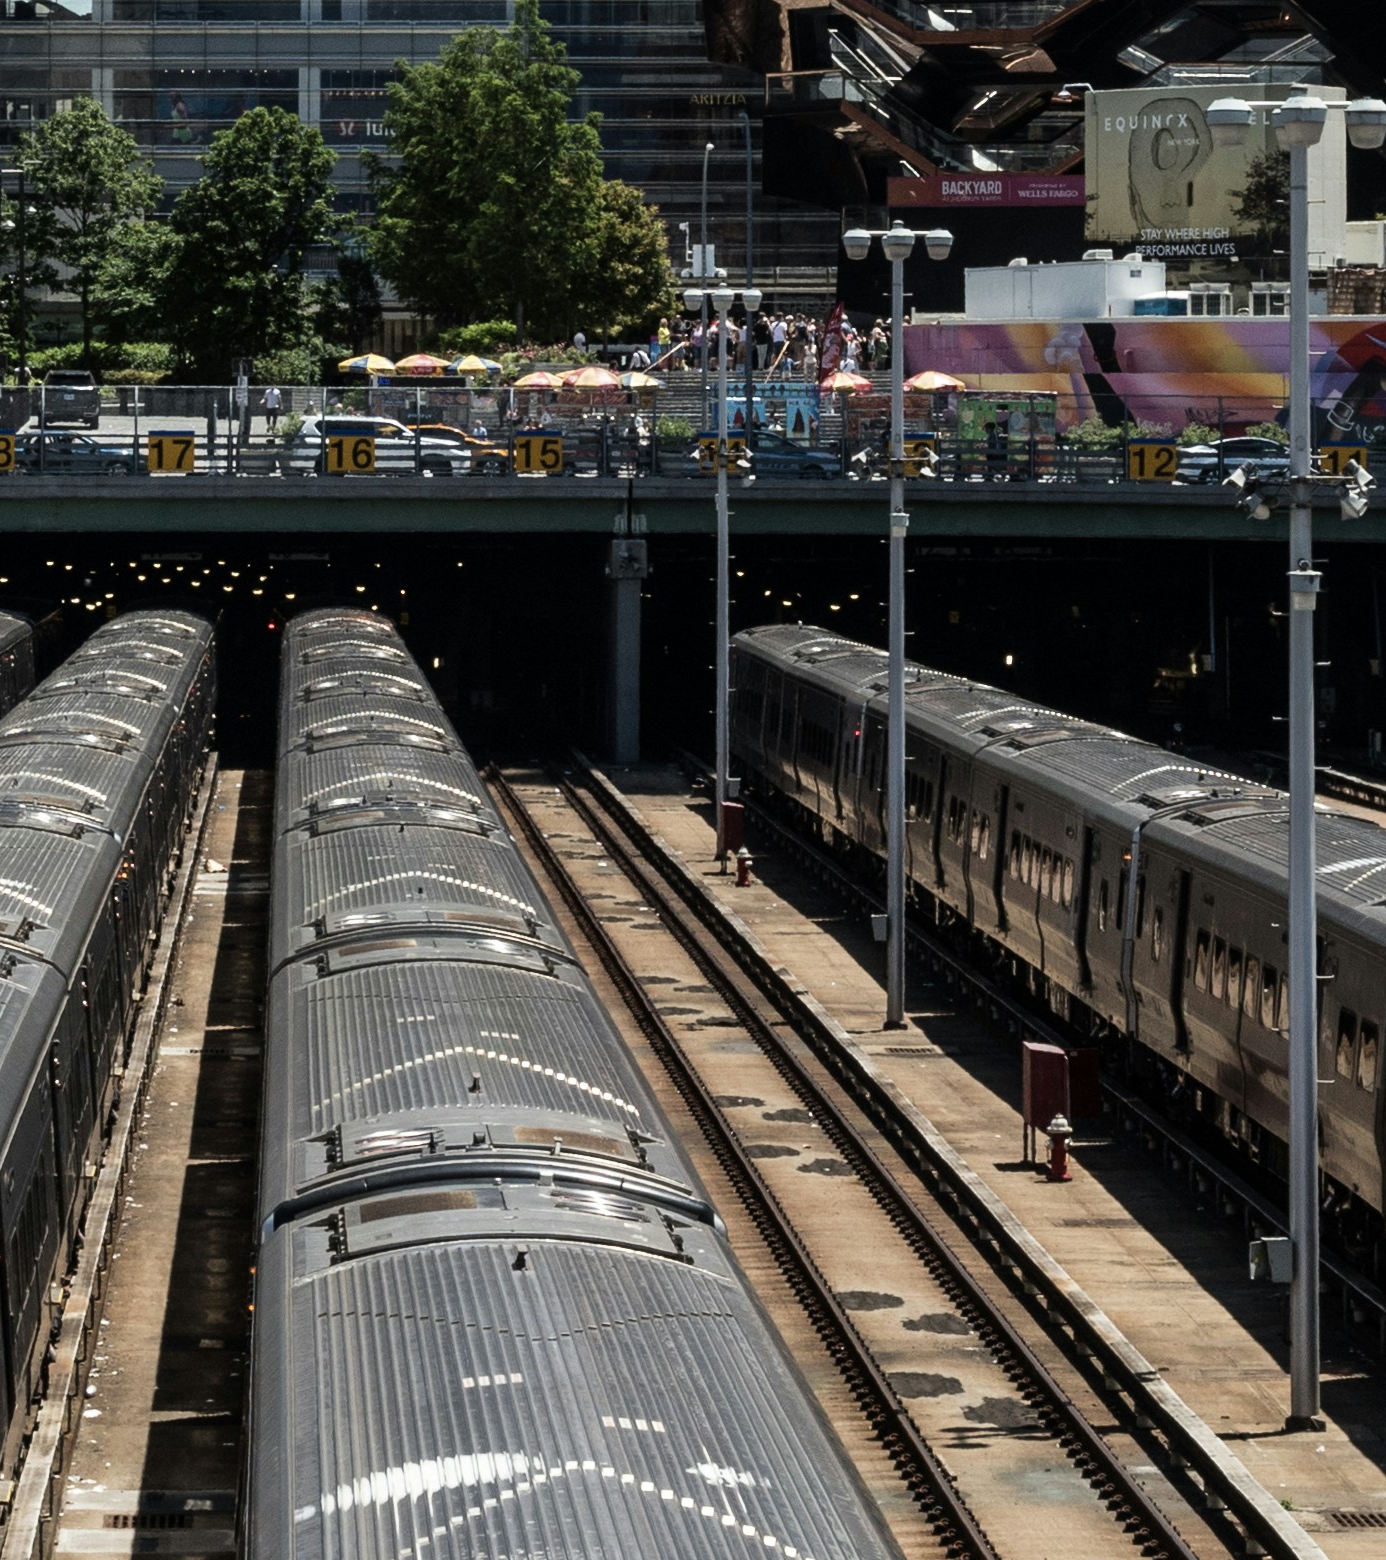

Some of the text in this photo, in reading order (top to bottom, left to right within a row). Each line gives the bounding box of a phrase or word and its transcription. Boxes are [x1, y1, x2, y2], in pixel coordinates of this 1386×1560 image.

[942, 180, 1003, 195] BACKYARD
[1017, 190, 1079, 199] WELLS FARGO
[1140, 227, 1230, 241] STAY WHERE HIGH
[1135, 242, 1236, 256] PERFORMANCE LIVES
[150, 439, 192, 470] 17
[330, 438, 372, 469] 16
[518, 439, 560, 470] 15
[1132, 447, 1174, 477] 12
